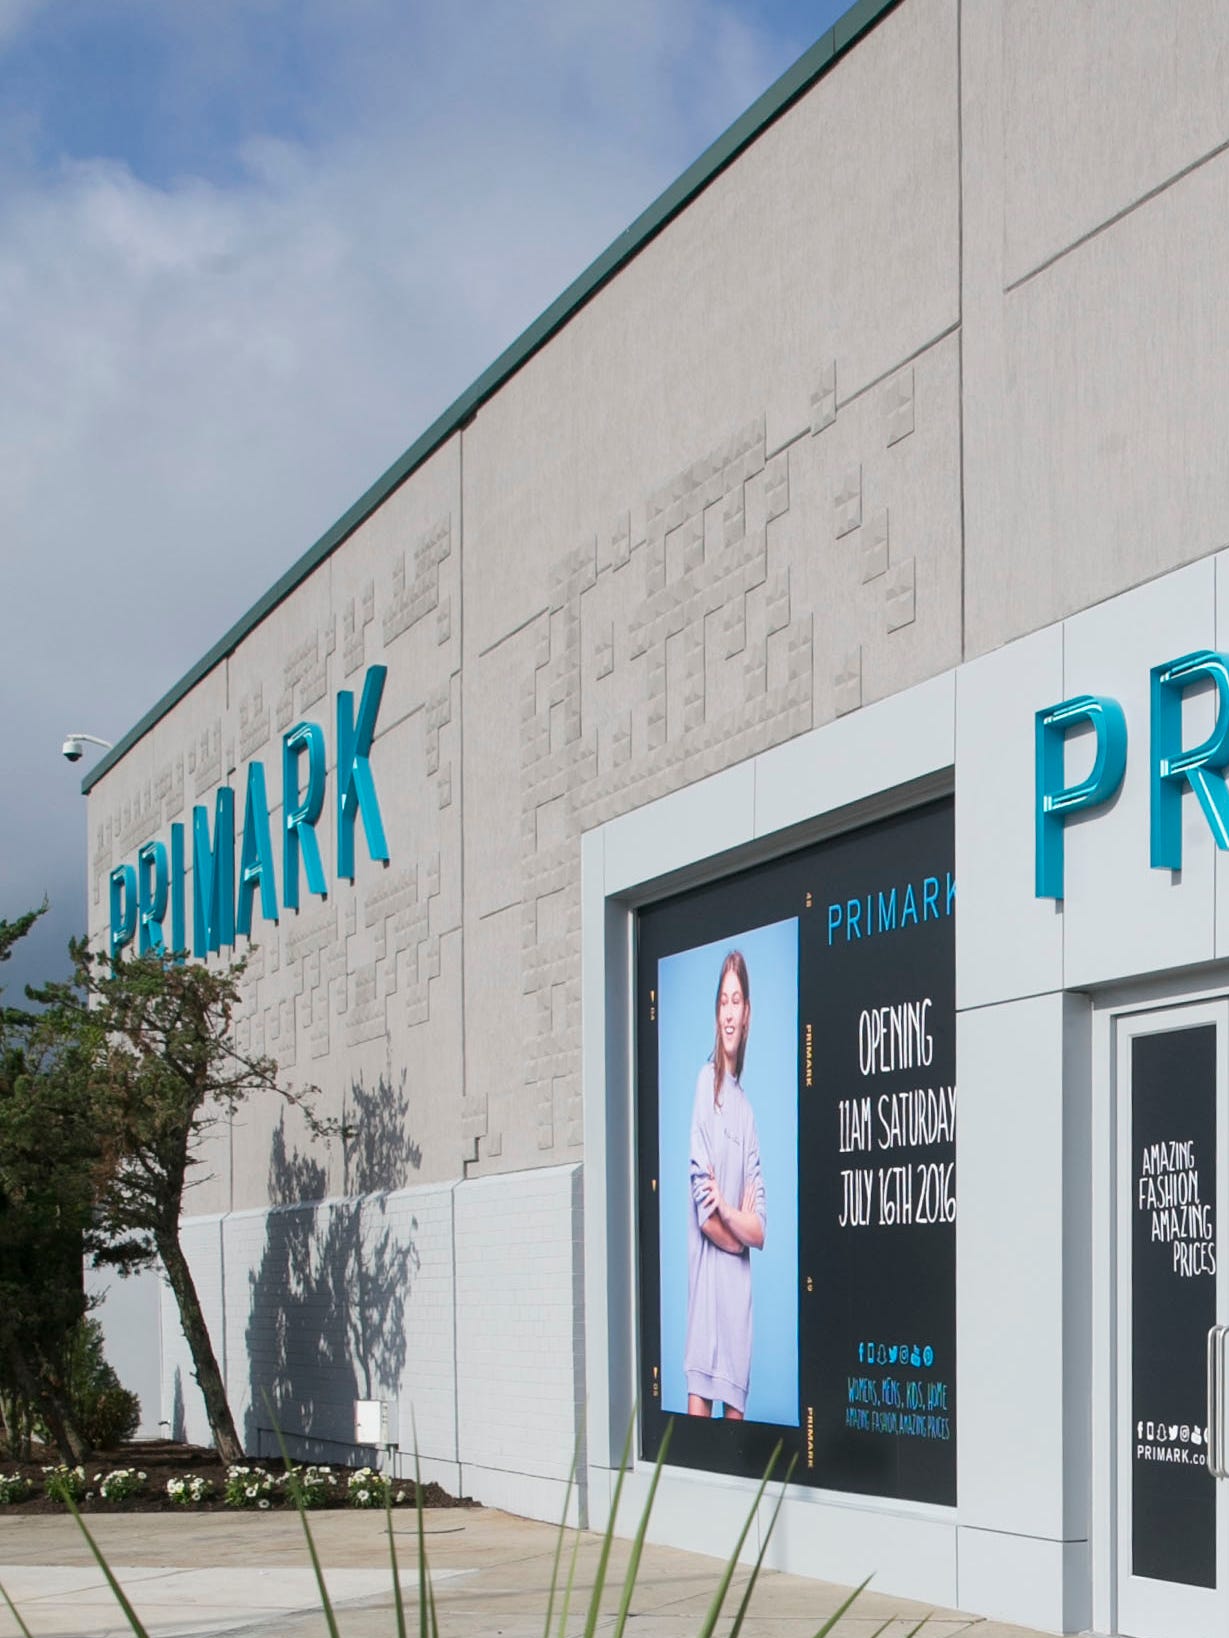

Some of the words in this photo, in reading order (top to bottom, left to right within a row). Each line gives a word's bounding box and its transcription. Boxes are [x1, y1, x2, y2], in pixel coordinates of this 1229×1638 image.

[110, 664, 390, 980] PRIMARK
[804, 1023, 813, 1088] PRIMARK
[858, 998, 933, 1076] OPENING
[838, 1096, 872, 1153] 11AM
[877, 1086, 956, 1151] SATURDAY
[1142, 1140, 1195, 1176] AMAZING
[838, 1166, 873, 1227] JULY
[878, 1164, 912, 1226] 16TH
[915, 1162, 956, 1224] 2016
[1151, 1204, 1213, 1243] AMAZING
[1173, 1240, 1216, 1277] PRICES
[806, 1406, 815, 1468] PRIMARK
[1137, 1444, 1209, 1467] PRIMARK.co
